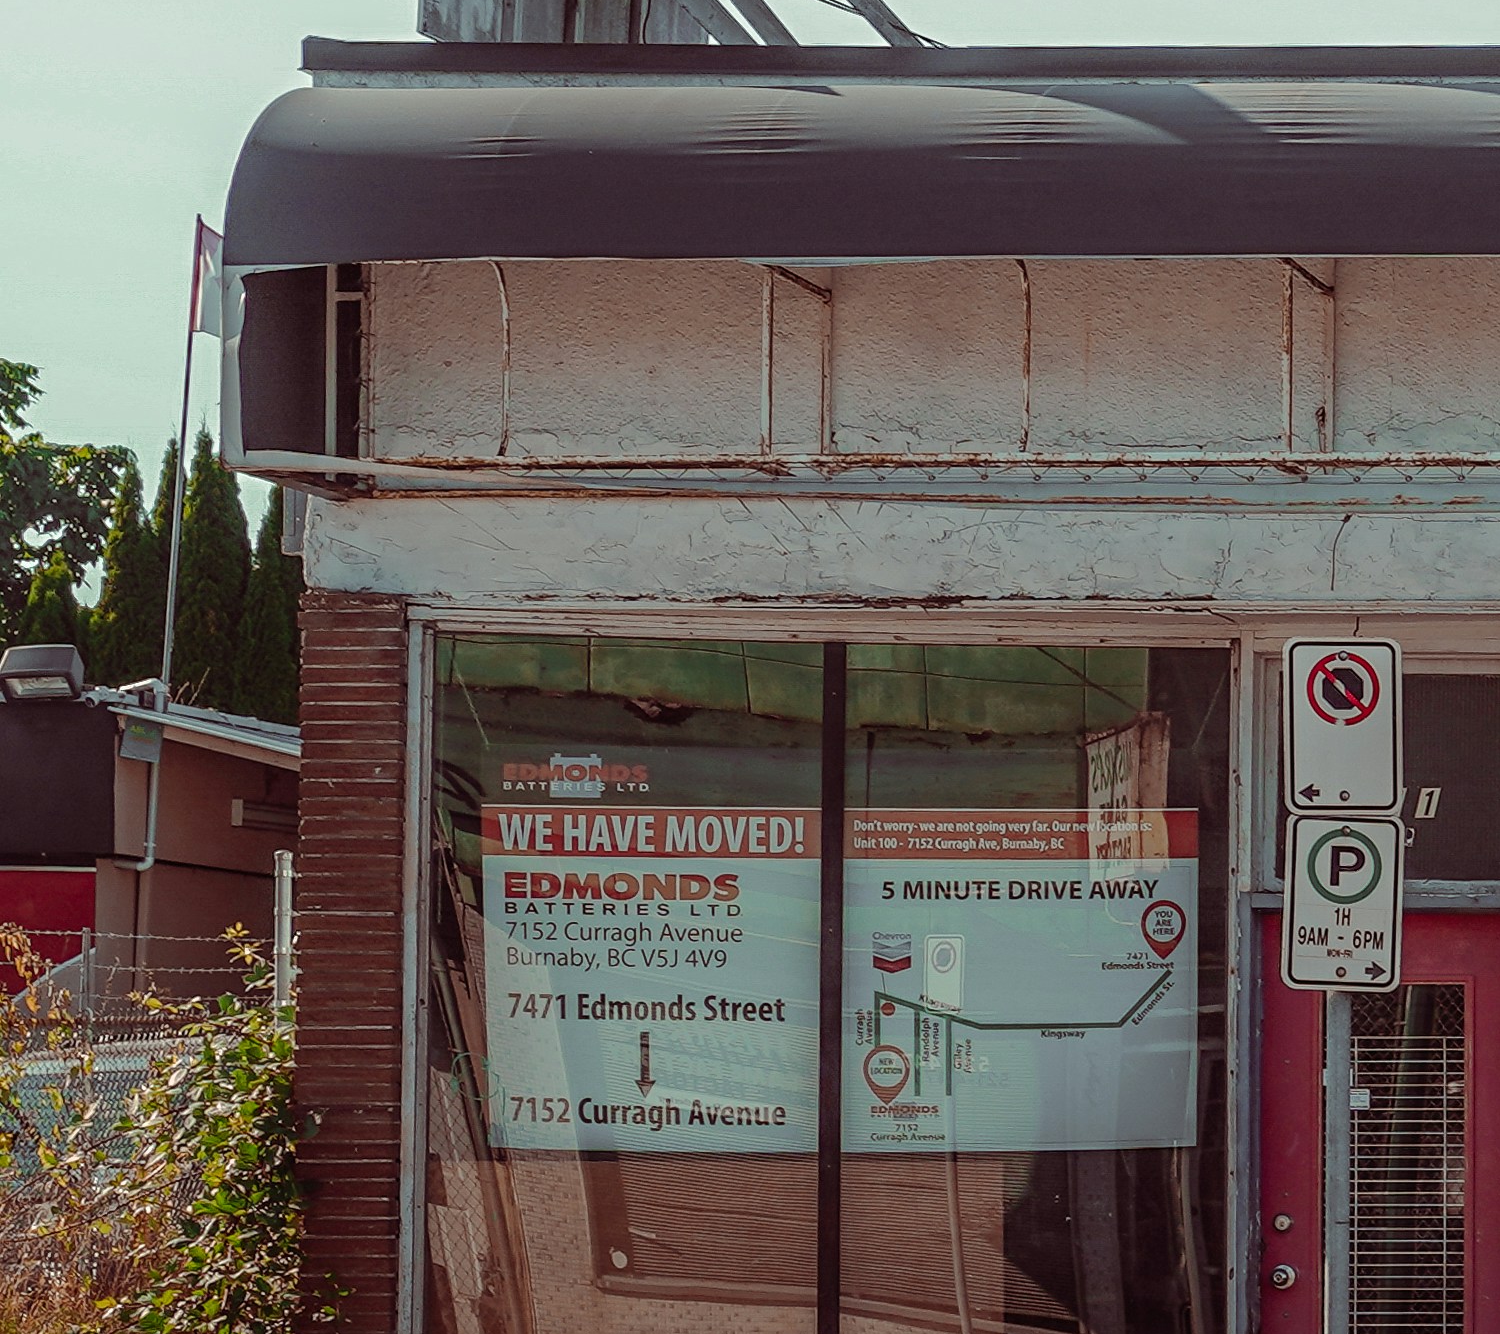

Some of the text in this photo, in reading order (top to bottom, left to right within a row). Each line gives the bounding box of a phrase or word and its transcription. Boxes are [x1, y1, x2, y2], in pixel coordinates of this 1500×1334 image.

[502, 763, 649, 782] EDMONDS
[502, 782, 606, 792] BATTERIES
[499, 813, 806, 854] WE HAVE MOVED!
[853, 819, 882, 832] Don't
[918, 821, 936, 832] we
[937, 821, 954, 832] are
[956, 820, 974, 832] not
[975, 821, 1006, 835] going
[1007, 821, 1030, 835] very
[1051, 820, 1071, 833] Our
[1072, 822, 1096, 833] new
[1097, 820, 1139, 833] location
[853, 837, 877, 850] Unit
[878, 837, 897, 850] 100
[907, 837, 933, 850] 7152
[935, 838, 977, 852] Curragh
[1002, 837, 1049, 852] Burnaby,
[1050, 838, 1064, 850] BC
[503, 871, 741, 902] EDMONDS
[881, 879, 1160, 901] 5 MINUTE DRIVE AWAY
[504, 901, 670, 916] BATTERIES
[1154, 910, 1173, 918] YOU
[1154, 919, 1172, 927] ARE
[1334, 908, 1351, 927] 1H
[506, 921, 744, 947] 7152 Curragh Avenue
[871, 931, 912, 940] Chevron
[1152, 927, 1175, 936] HERE
[1297, 925, 1329, 947] 9AM
[1352, 929, 1385, 951] 6PM
[506, 946, 728, 972] Burnaby, BC V5J 4V9
[1101, 961, 1175, 970] Edmonds Street
[507, 992, 786, 1022] 7471 Edmonds Street
[1131, 989, 1165, 1026] Edmonds
[1040, 1029, 1086, 1040] Kingsway
[510, 1097, 787, 1132] 7152 Curragh Avenue
[870, 1105, 939, 1114] EDMONDS
[909, 1133, 945, 1142] Avenue
